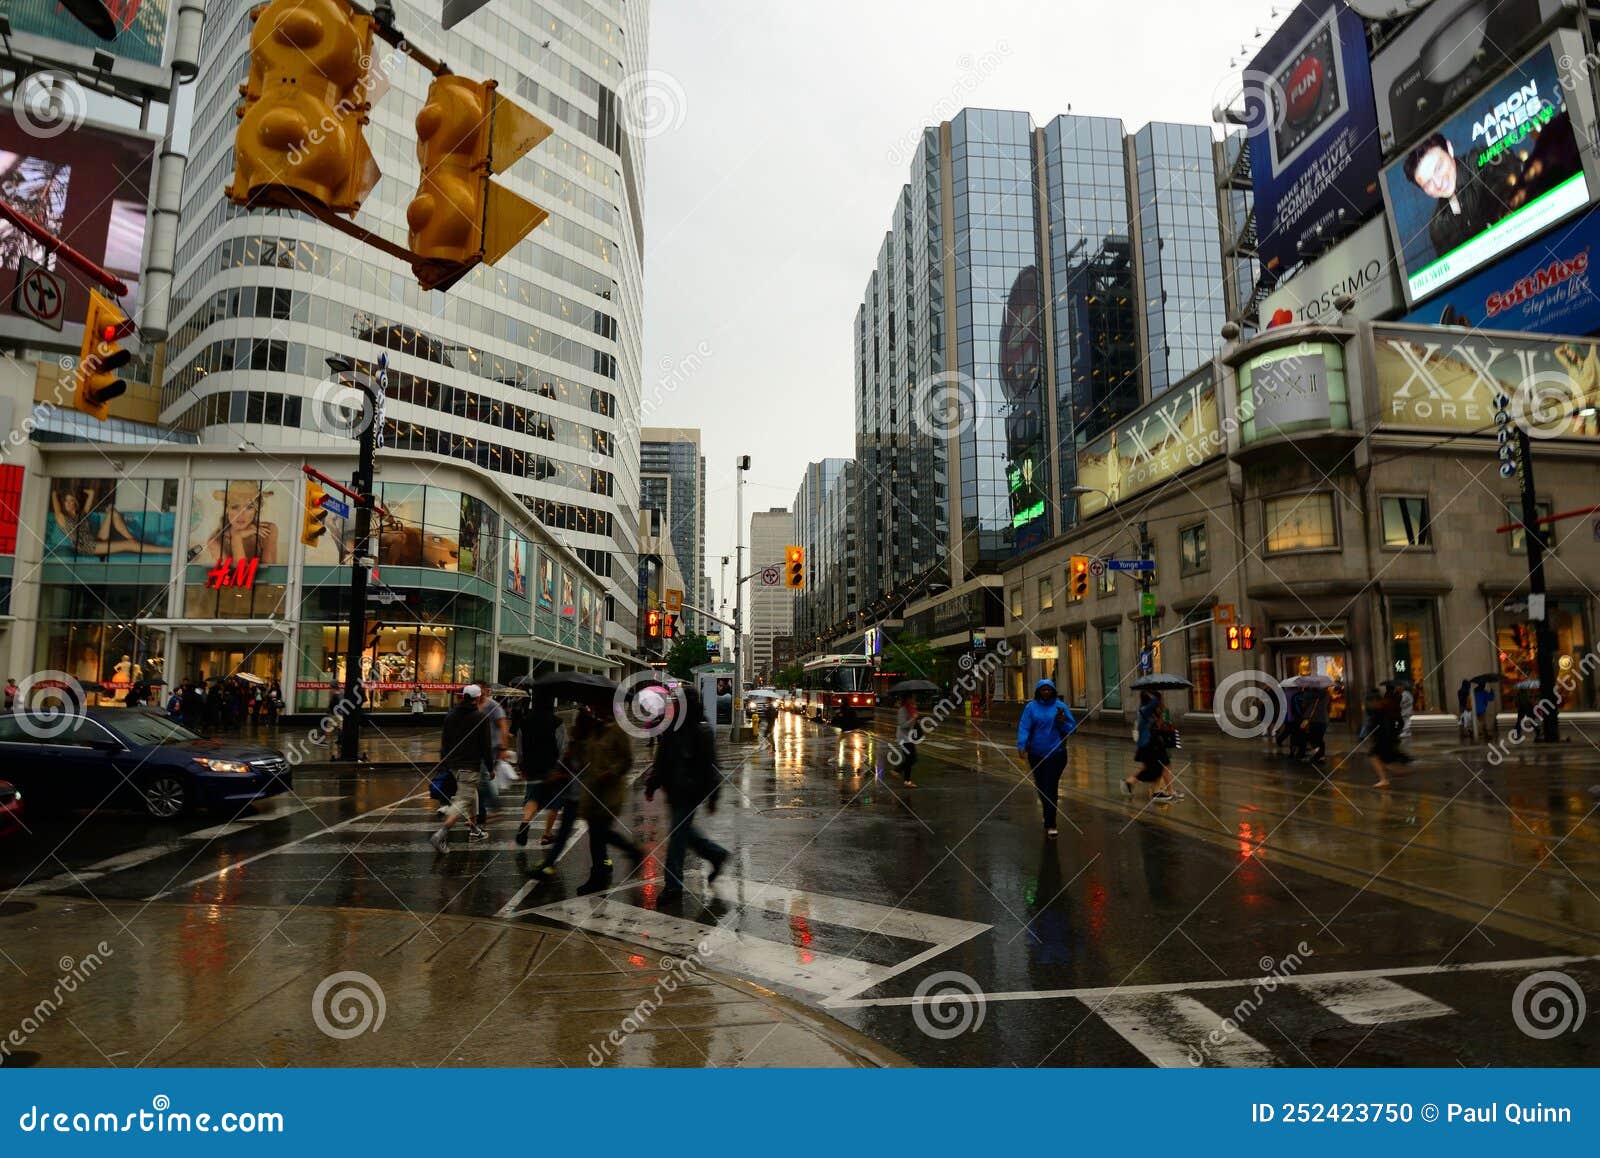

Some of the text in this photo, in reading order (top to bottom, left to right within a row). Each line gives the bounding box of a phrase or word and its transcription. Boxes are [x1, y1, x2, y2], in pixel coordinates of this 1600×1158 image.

[1291, 68, 1317, 104] FUN
[1472, 79, 1538, 142] AARON
[1485, 96, 1542, 147] LINES
[1277, 181, 1299, 213] MAKE
[1300, 159, 1318, 186] THIS
[1280, 179, 1313, 223] COME
[1314, 140, 1348, 187] ALIVE
[1387, 340, 1538, 406] XXI
[1126, 382, 1207, 472] XXI
[206, 556, 259, 591] H&M
[1119, 560, 1139, 570] Yonge
[1285, 624, 1321, 639] XXI
